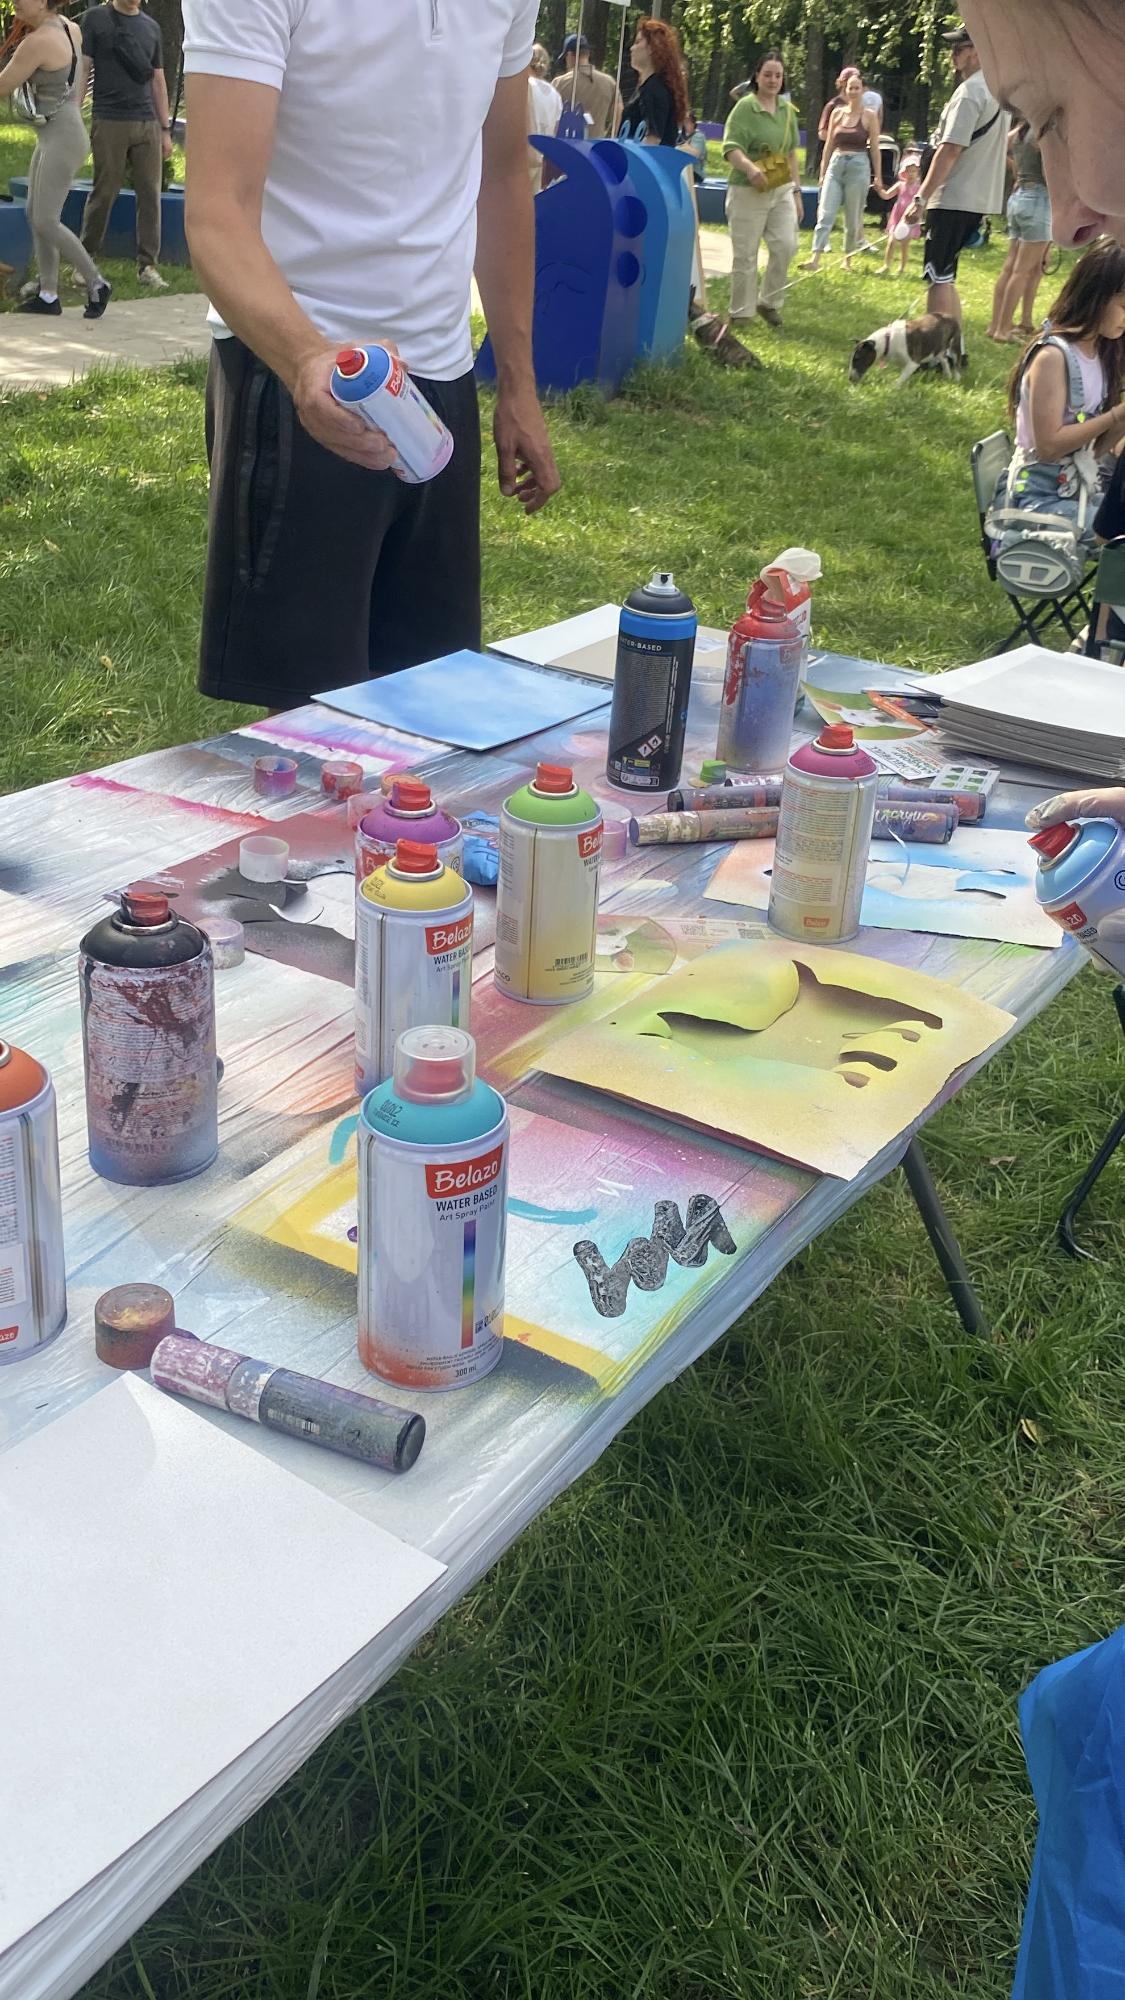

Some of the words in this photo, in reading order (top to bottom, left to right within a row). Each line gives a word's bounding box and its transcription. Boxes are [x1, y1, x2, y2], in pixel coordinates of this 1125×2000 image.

[434, 953, 457, 965] WATER
[434, 1160, 498, 1193] Belazo
[436, 1197, 471, 1212] WATER
[473, 1184, 498, 1205] BASED
[440, 1213, 453, 1221] Art
[455, 1208, 478, 1220] Spray
[455, 1368, 468, 1377] 300
[468, 1365, 477, 1374] ml
